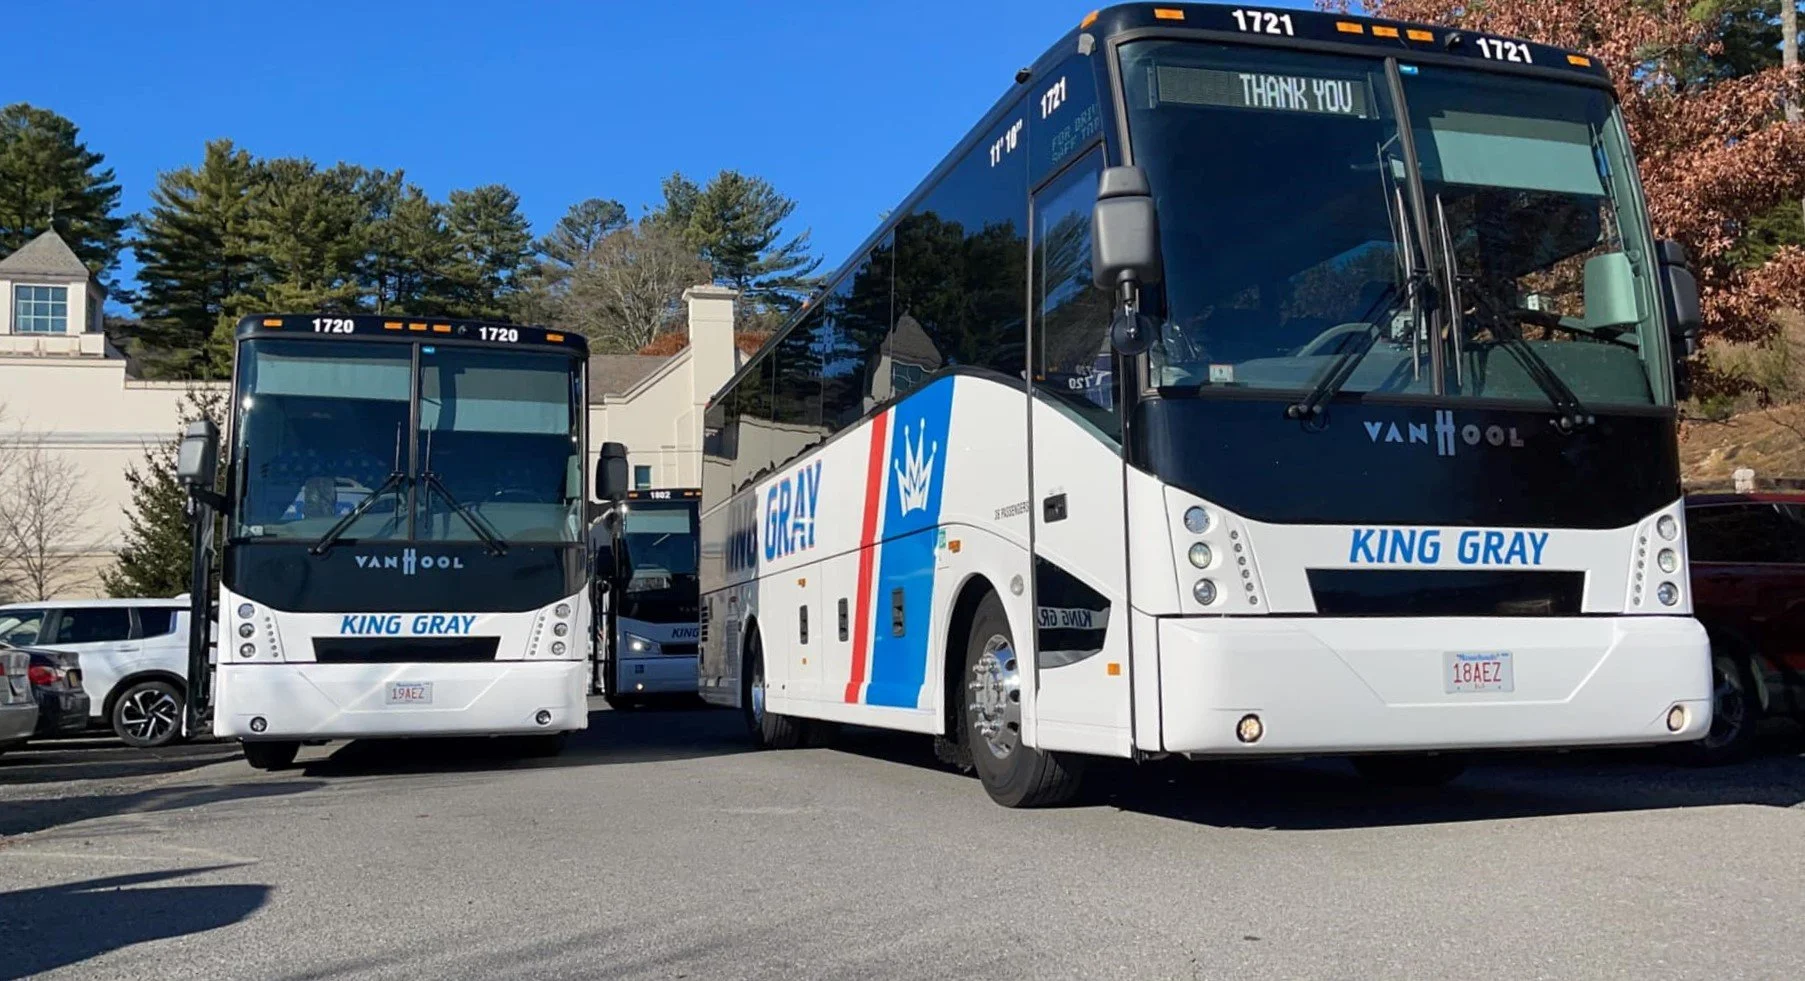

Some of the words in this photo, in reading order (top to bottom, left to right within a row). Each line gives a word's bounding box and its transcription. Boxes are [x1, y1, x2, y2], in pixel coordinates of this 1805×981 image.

[1232, 9, 1295, 36] 1721
[1475, 37, 1533, 64] 1721
[1041, 76, 1066, 119] 1721
[1239, 73, 1309, 111] THANK
[1313, 79, 1353, 112] YOU
[312, 318, 354, 334] 1720
[479, 326, 518, 342] 1720
[765, 459, 822, 562] GRAY
[1349, 528, 1441, 564] KING
[1457, 531, 1549, 565] GRAY
[340, 615, 402, 635] KING
[412, 615, 476, 635] GRAY
[672, 627, 700, 639] KING
[1453, 662, 1502, 683] 18AEZ
[392, 687, 425, 700] 19AEZ
